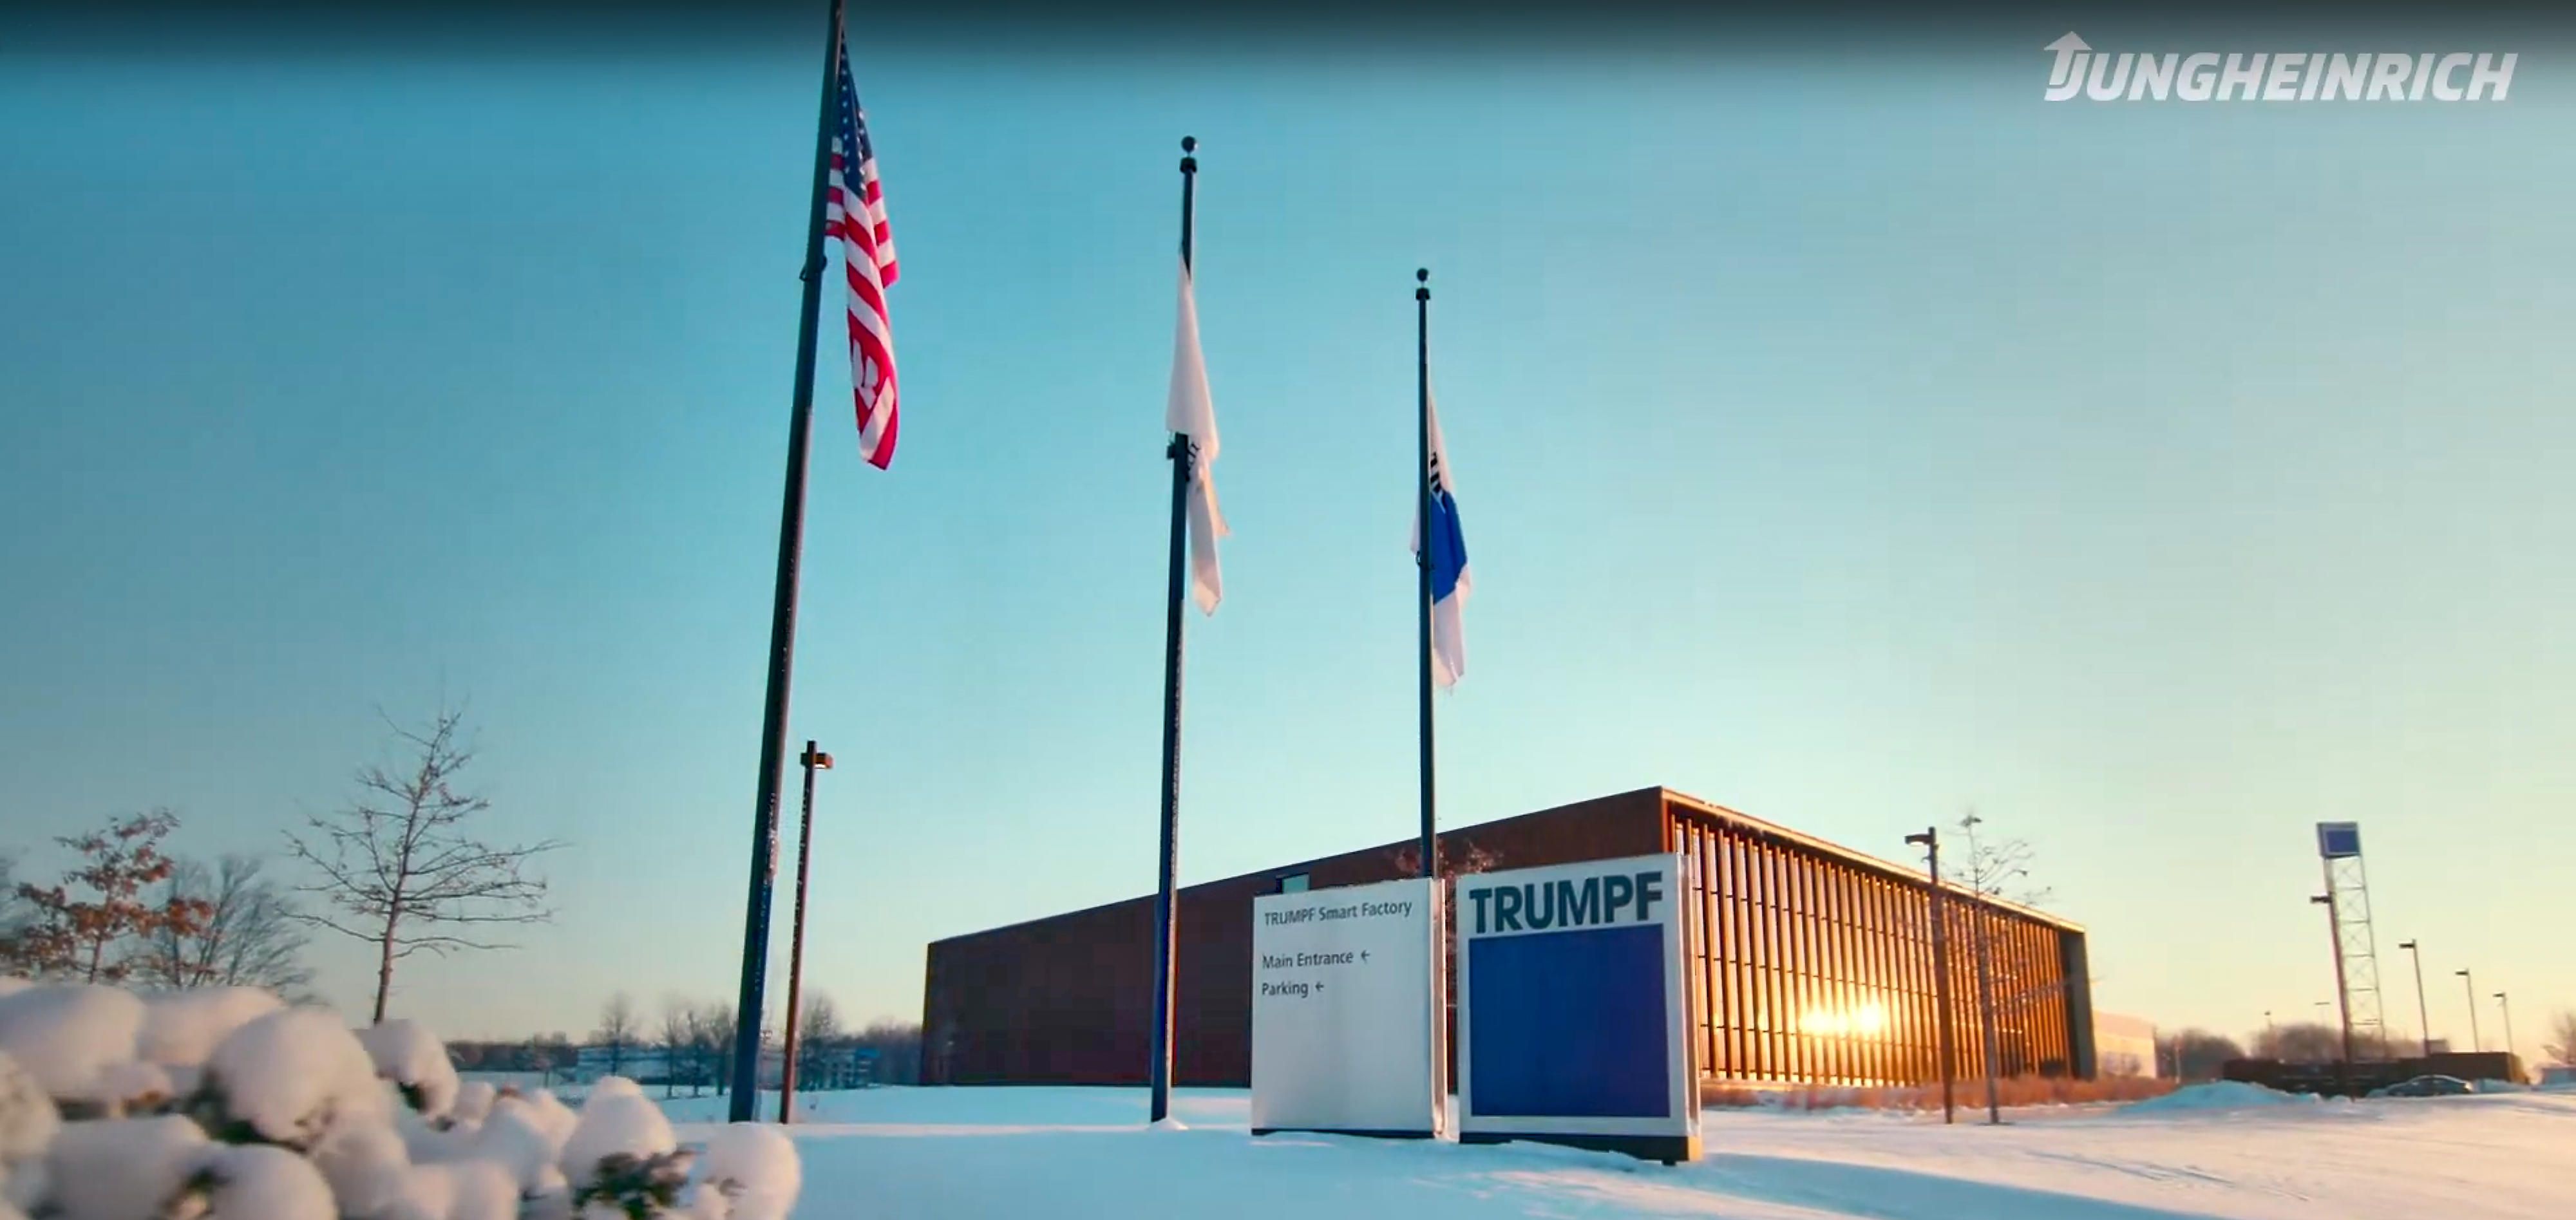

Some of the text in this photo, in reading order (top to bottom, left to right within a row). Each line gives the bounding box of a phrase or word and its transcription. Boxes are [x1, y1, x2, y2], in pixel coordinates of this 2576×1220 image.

[1264, 901, 1412, 926] TRUMPF Smart Factory
[1469, 871, 1663, 934] TRUMPF
[1262, 951, 1354, 970] Main Entrance
[1262, 981, 1309, 999] Parking
